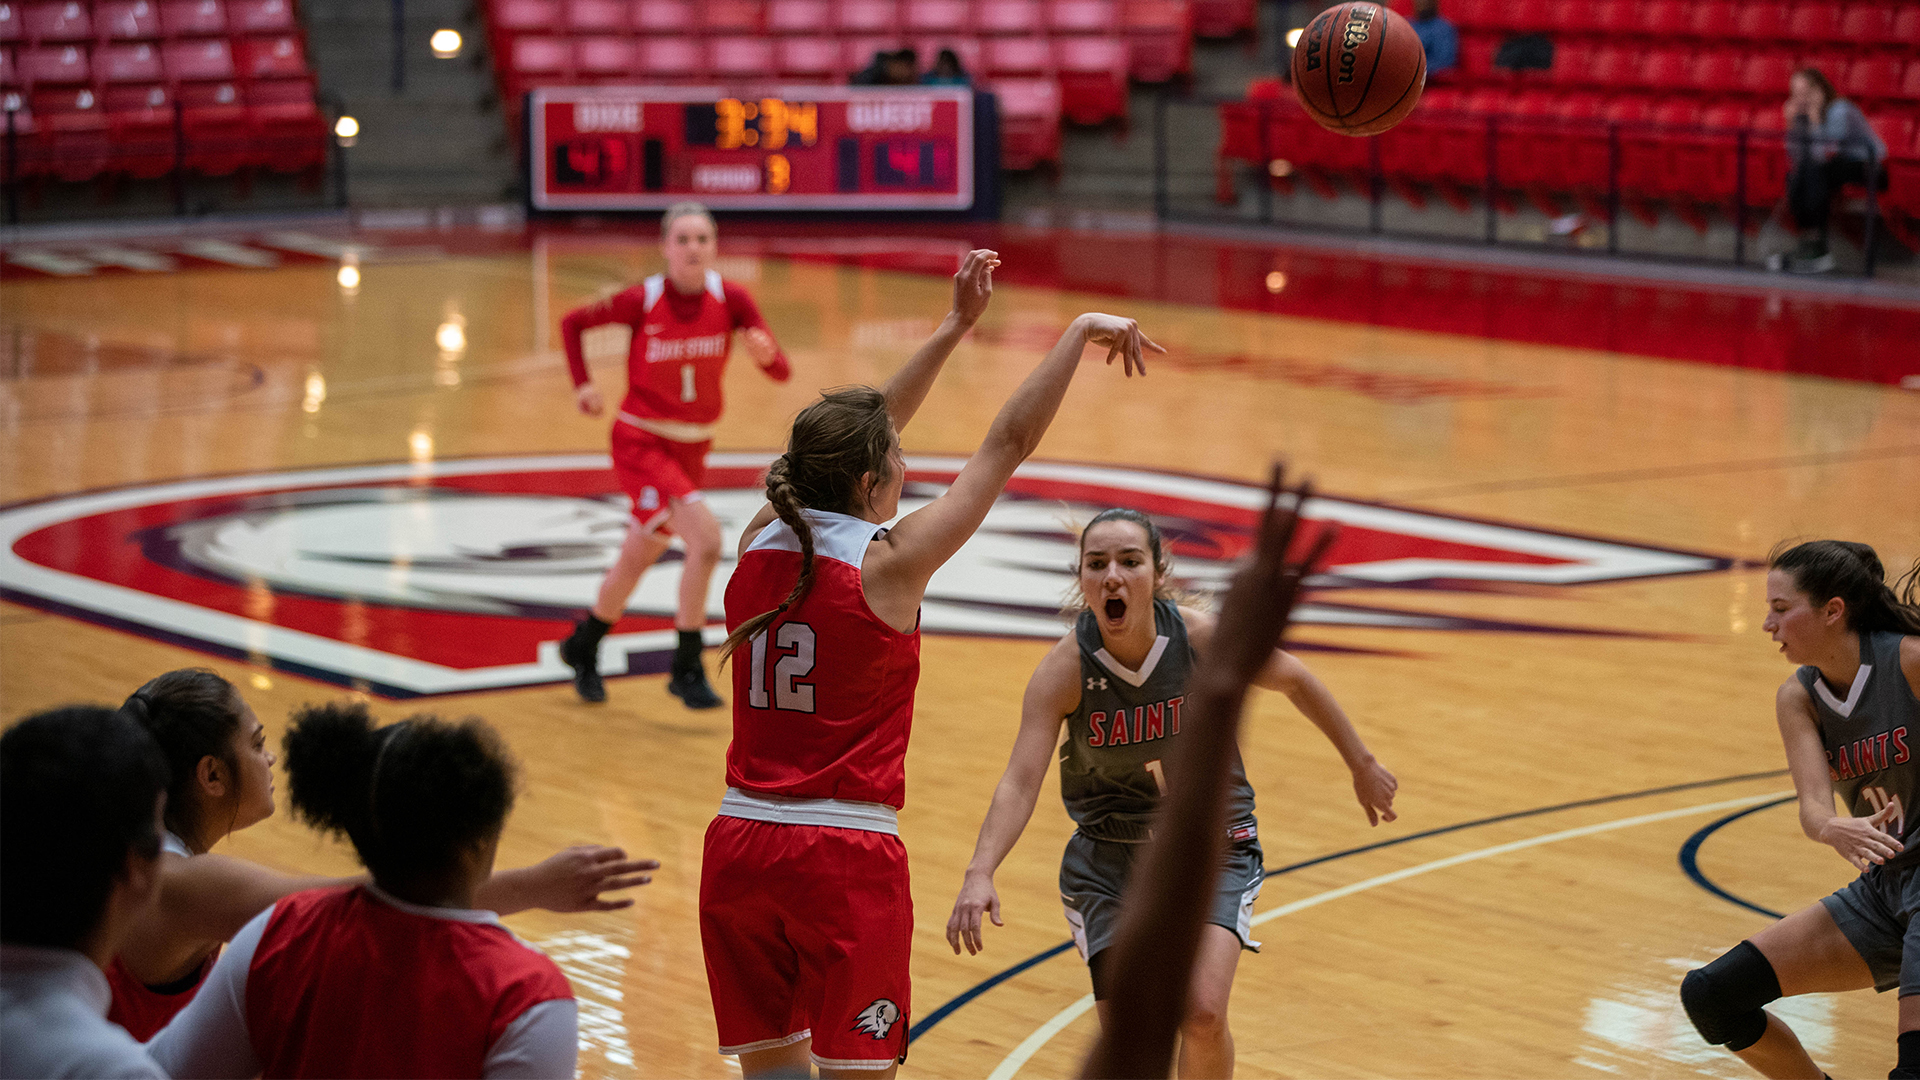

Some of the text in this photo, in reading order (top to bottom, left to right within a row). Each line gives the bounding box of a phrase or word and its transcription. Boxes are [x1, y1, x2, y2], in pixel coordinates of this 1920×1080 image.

[716, 98, 818, 149] 3:34
[847, 101, 932, 131] GUEST
[765, 154, 790, 194] 3
[681, 363, 697, 402] 1
[748, 621, 816, 714] 12
[1088, 694, 1192, 748] SAINT
